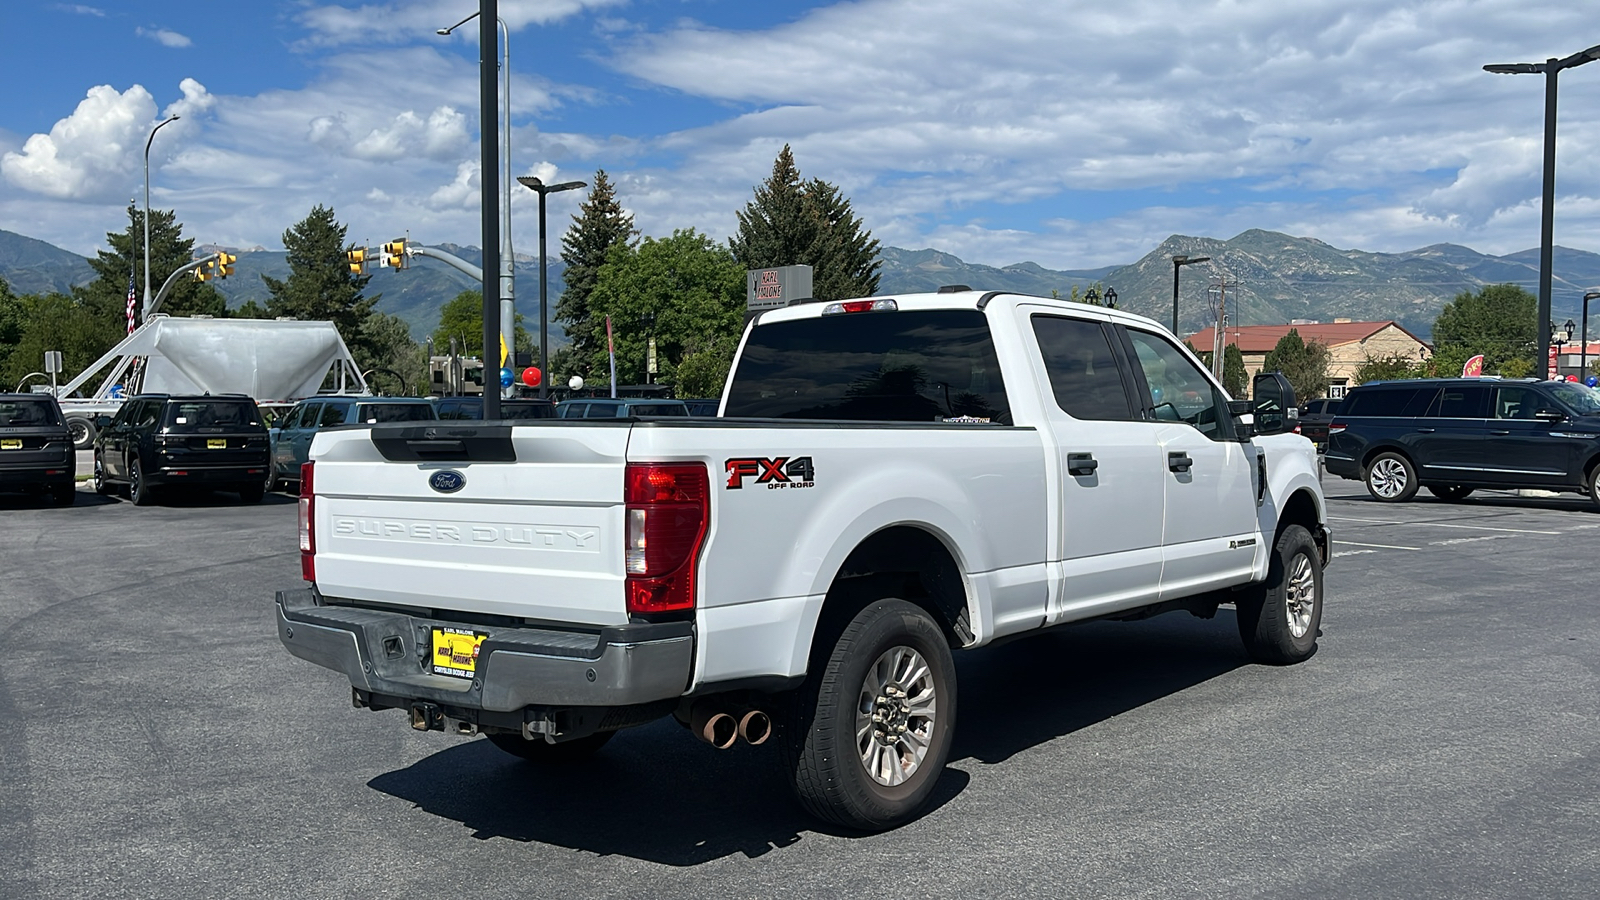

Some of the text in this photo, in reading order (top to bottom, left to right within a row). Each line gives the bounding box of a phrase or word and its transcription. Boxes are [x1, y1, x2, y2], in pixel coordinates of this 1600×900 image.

[761, 271, 778, 284] KARL
[757, 285, 782, 299] MALONE
[724, 456, 814, 490] FX4
[435, 474, 456, 488] Ford
[335, 518, 595, 548] SUPER DUTY
[438, 646, 450, 657] KARL
[453, 654, 473, 666] MALONE
